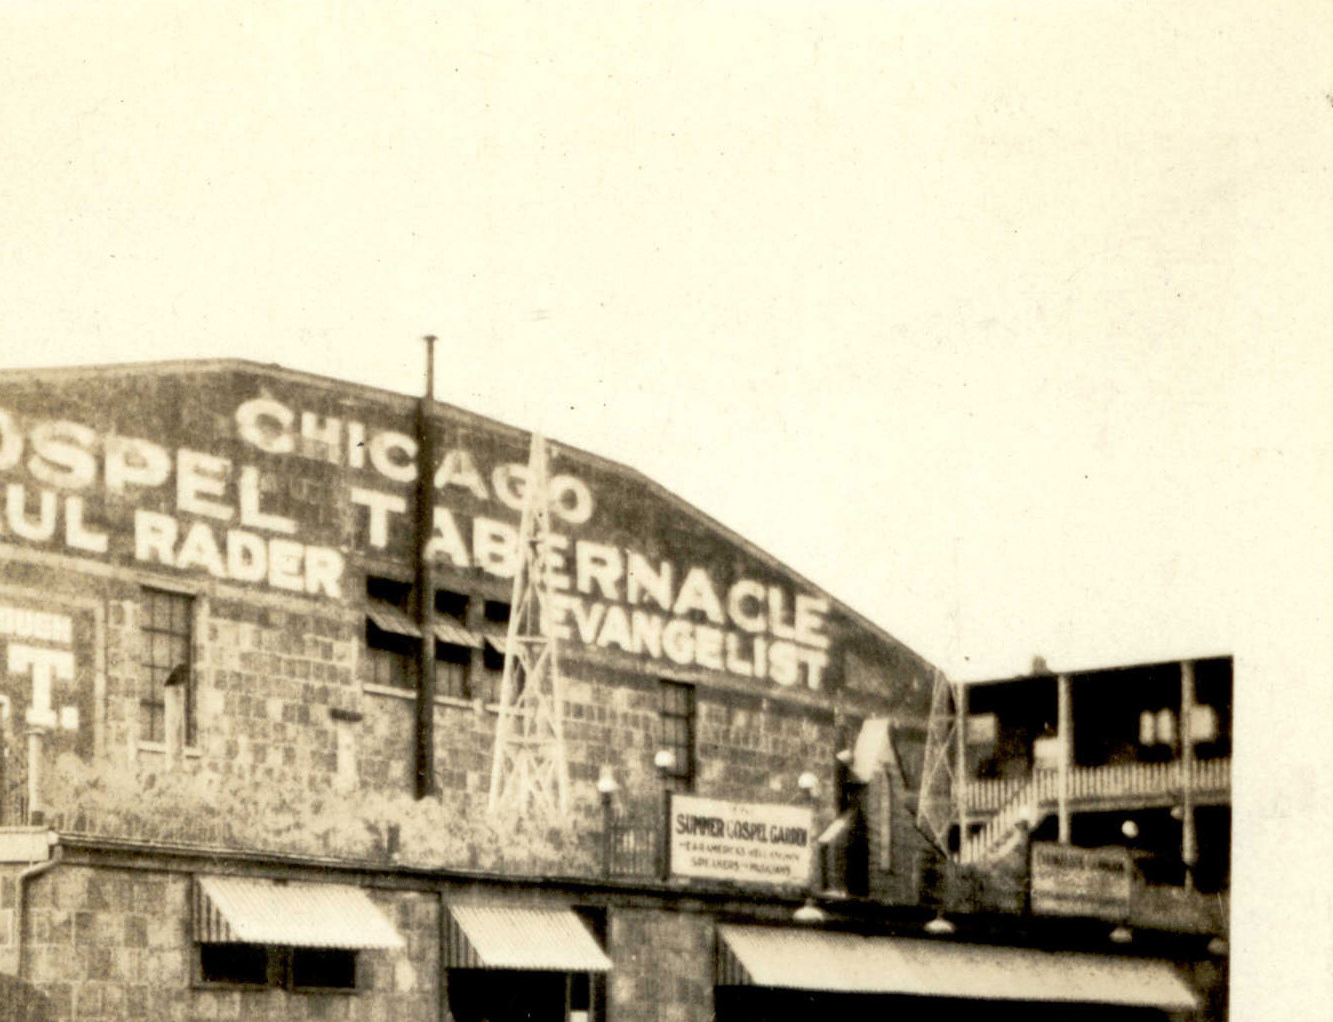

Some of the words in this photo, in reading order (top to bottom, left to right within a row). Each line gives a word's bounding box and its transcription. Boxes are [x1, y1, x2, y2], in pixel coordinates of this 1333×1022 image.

[235, 397, 595, 525] CHICAGO
[134, 507, 346, 599] RADER
[539, 595, 830, 691] EVANGELIST
[350, 487, 832, 649] TABERNACLE
[675, 813, 725, 839] SUMMER
